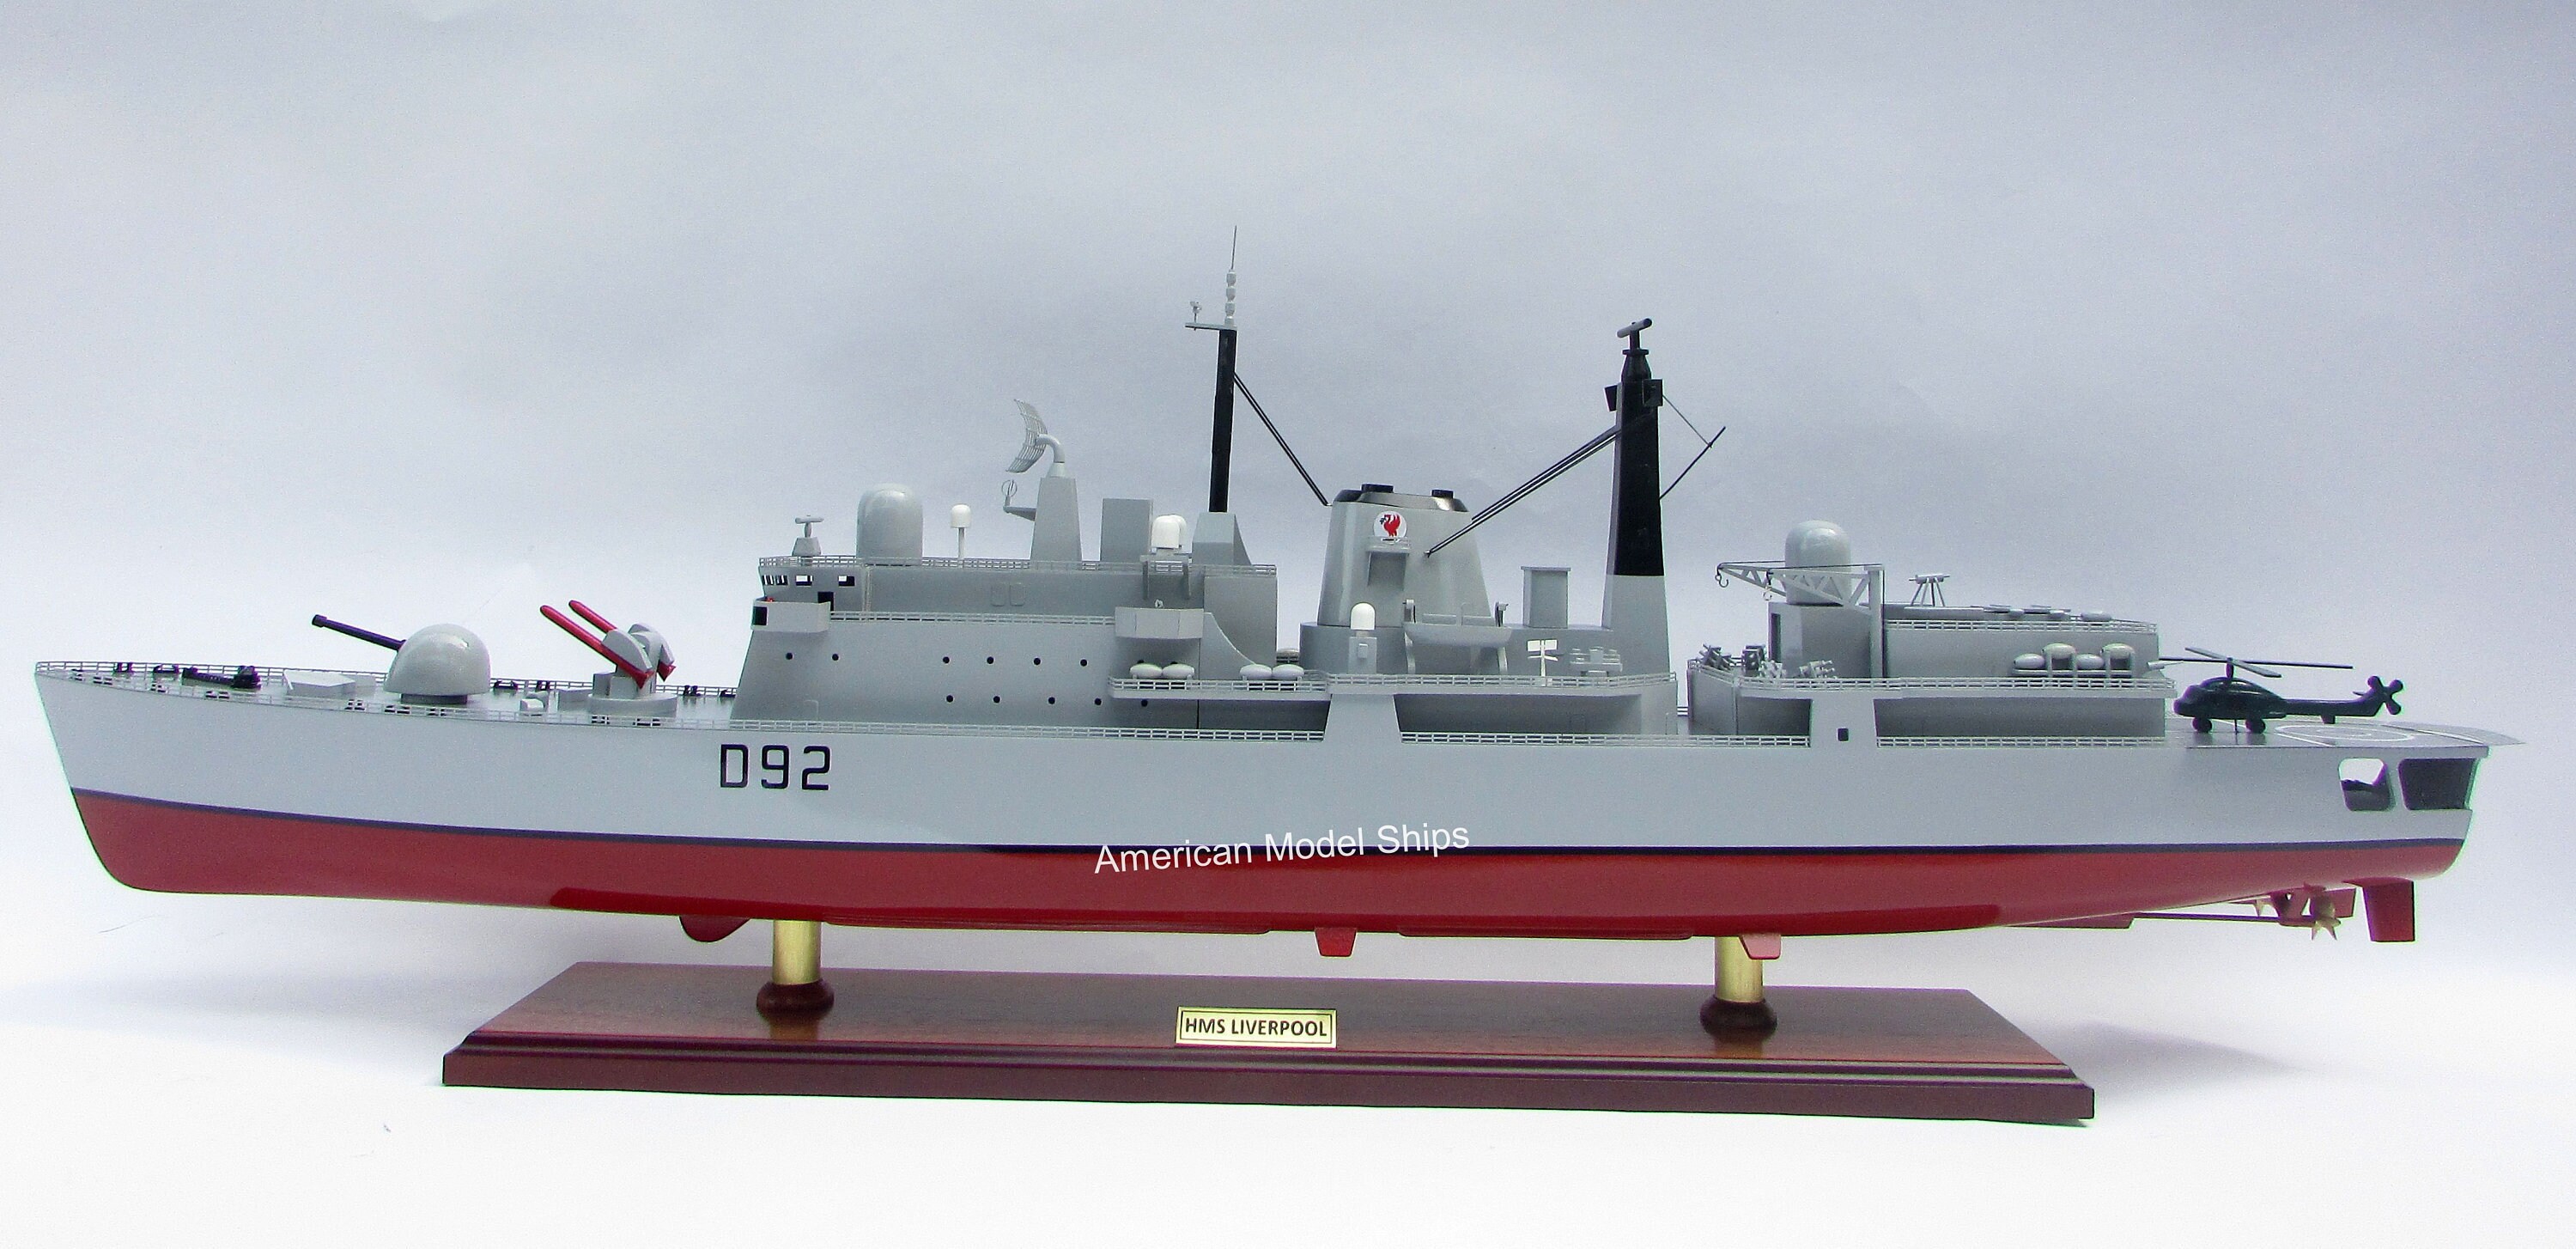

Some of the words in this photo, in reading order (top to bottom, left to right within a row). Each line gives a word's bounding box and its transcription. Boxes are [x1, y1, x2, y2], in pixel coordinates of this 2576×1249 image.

[720, 744, 831, 790] D92
[1185, 1017, 1225, 1034] HMS
[1231, 1019, 1327, 1036] LIVERPOOL
